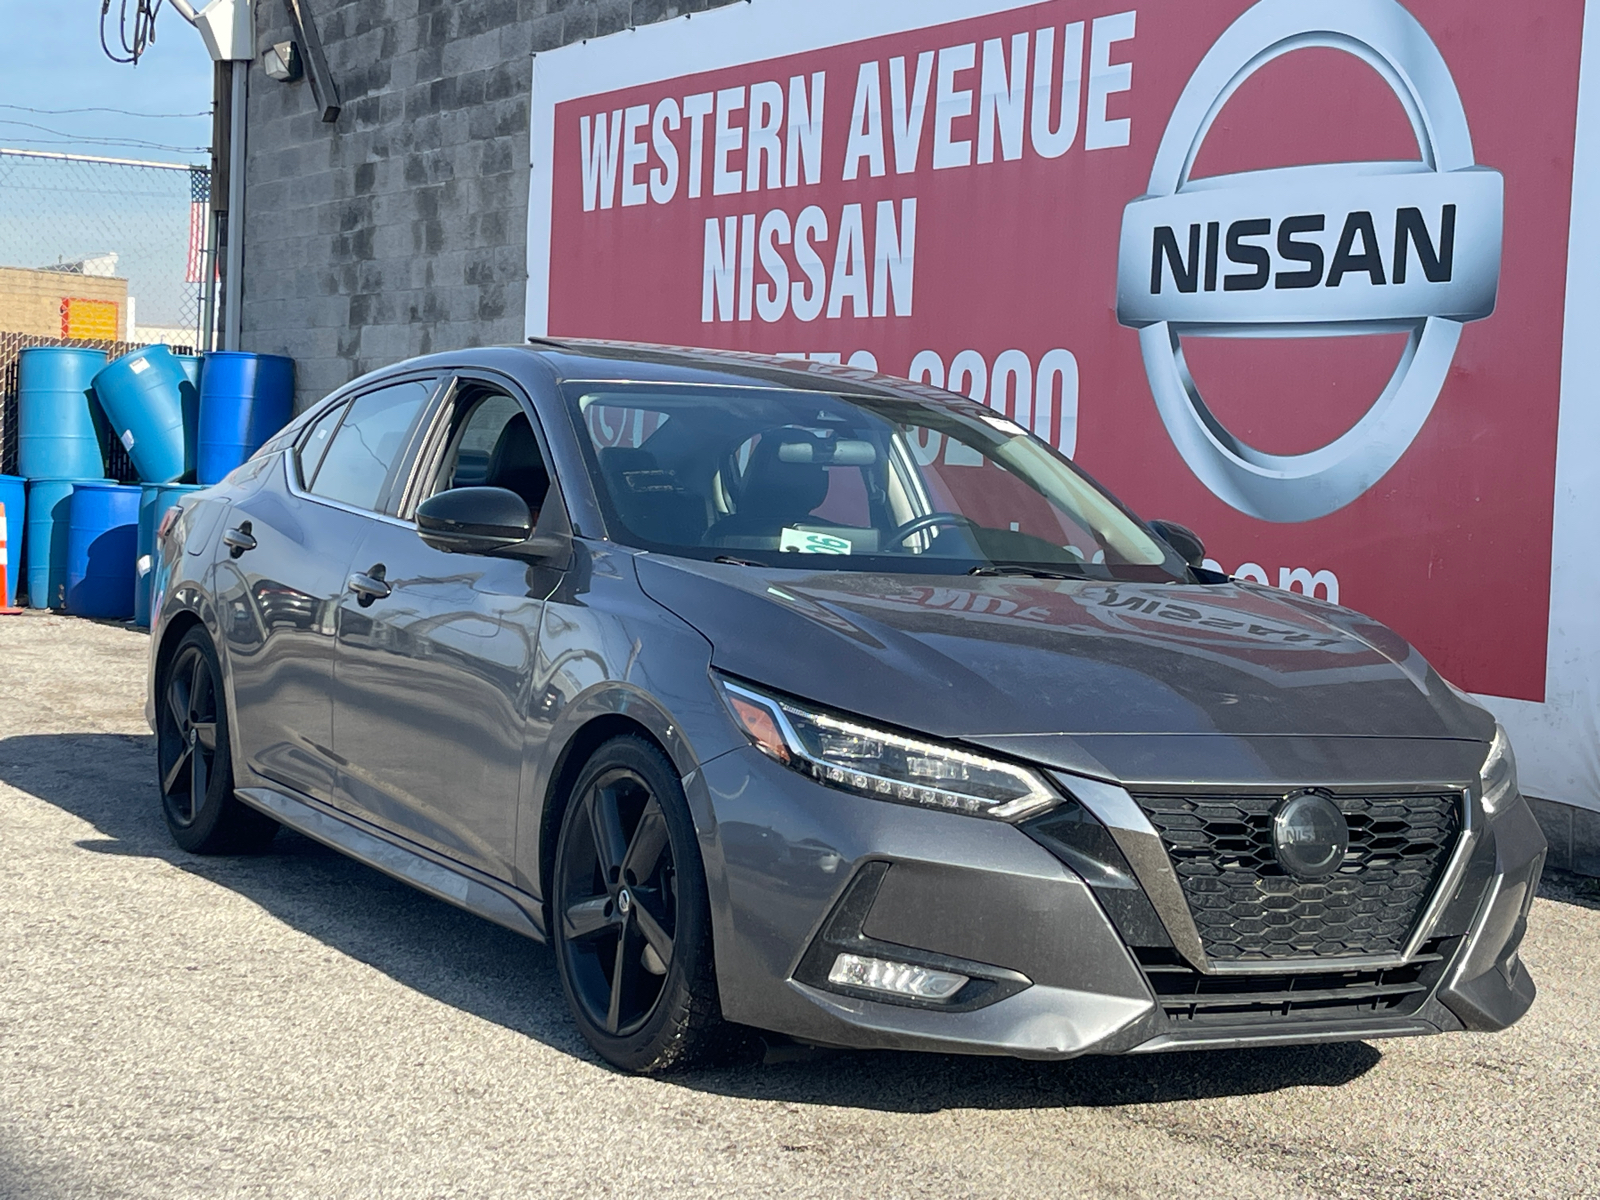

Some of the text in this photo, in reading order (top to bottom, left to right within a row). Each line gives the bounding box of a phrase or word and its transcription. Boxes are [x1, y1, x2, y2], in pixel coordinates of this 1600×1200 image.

[580, 10, 1137, 212] WESTERN AVENUE
[702, 198, 917, 323] NISSAN
[1150, 204, 1456, 294] NISSAN
